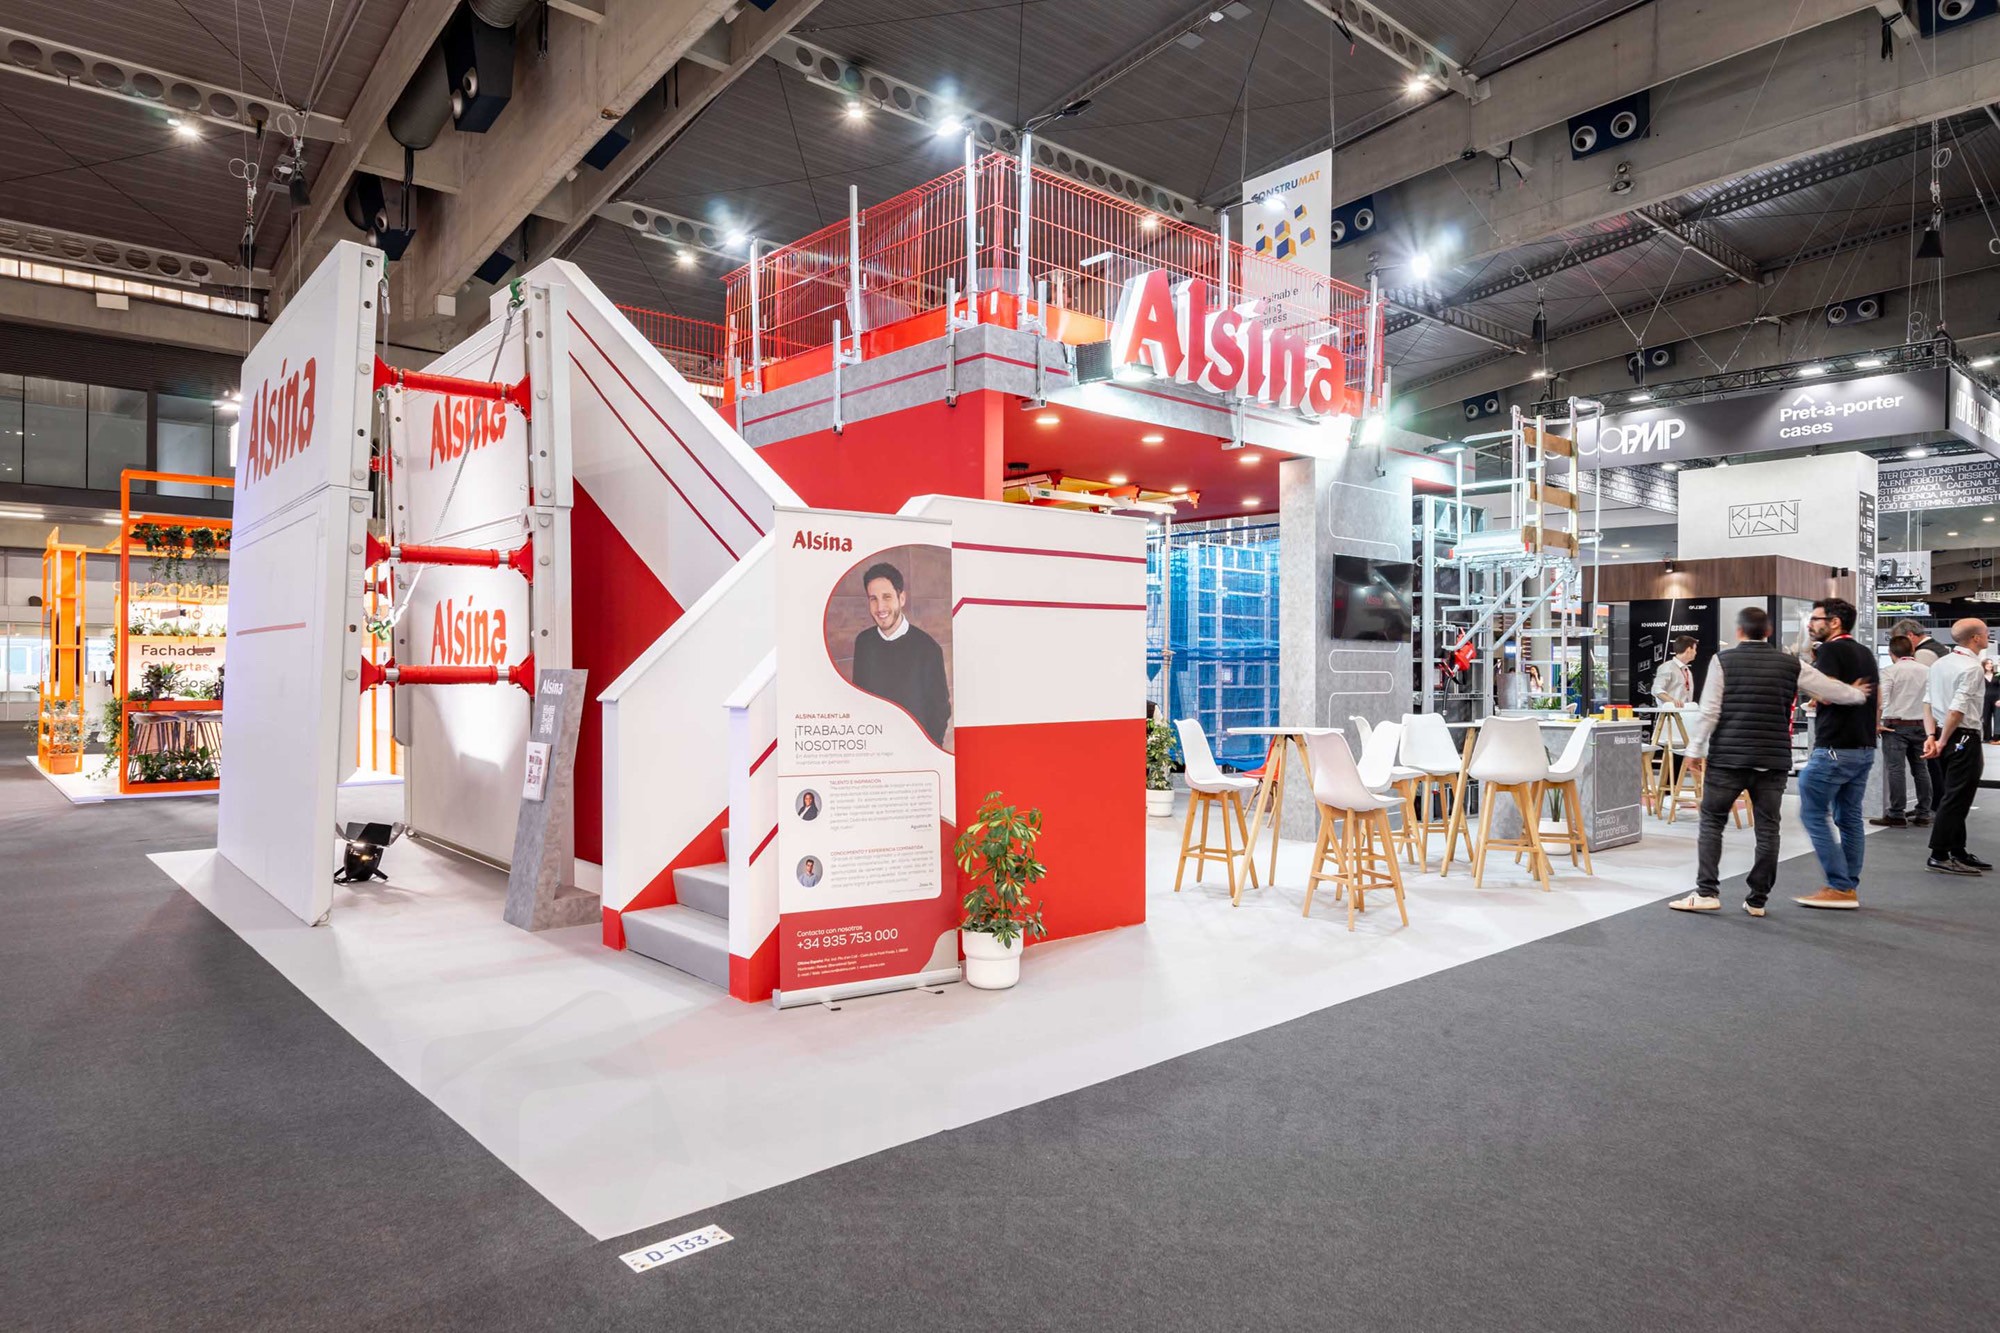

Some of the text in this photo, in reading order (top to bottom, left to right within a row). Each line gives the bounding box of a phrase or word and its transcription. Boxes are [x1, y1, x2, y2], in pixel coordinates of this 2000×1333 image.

[1779, 394, 1904, 422] Pret-à-porter
[1779, 422, 1834, 439] cases
[1946, 480, 1983, 489] CADENA
[1731, 502, 1797, 521] KHAN
[1731, 517, 1797, 536] VIAN
[794, 724, 883, 738] ¡TRABAJA CON
[795, 739, 867, 751] NOSOTROS!
[837, 925, 863, 933] nosotros
[797, 928, 899, 950] +34 935 753 000
[645, 1235, 710, 1262] D-133
